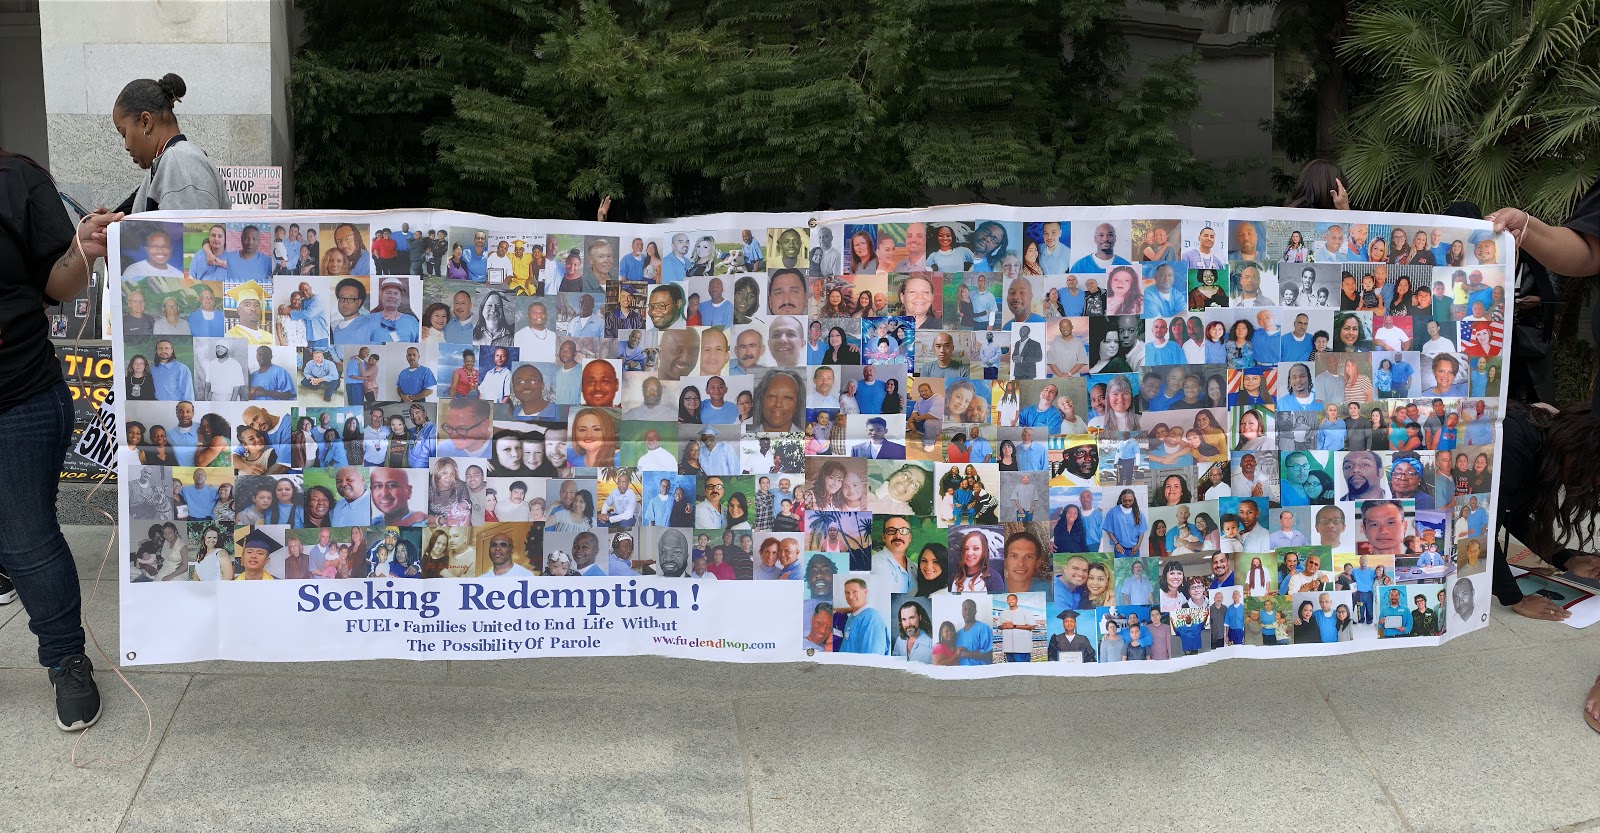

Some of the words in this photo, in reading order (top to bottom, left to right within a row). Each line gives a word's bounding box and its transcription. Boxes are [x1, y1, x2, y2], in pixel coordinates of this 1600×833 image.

[217, 168, 231, 177] ING
[233, 168, 280, 178] REDEMPTION
[230, 193, 267, 204] pLWOP
[298, 581, 440, 618] Seeking
[458, 579, 679, 616] Redemption
[403, 620, 467, 633] Families
[472, 618, 523, 633] United
[525, 619, 541, 631] to
[544, 617, 576, 630] End
[583, 617, 614, 630] Life
[407, 639, 436, 652] The
[442, 638, 523, 653] Possibility
[525, 637, 544, 650] Of
[550, 635, 601, 649] Parole
